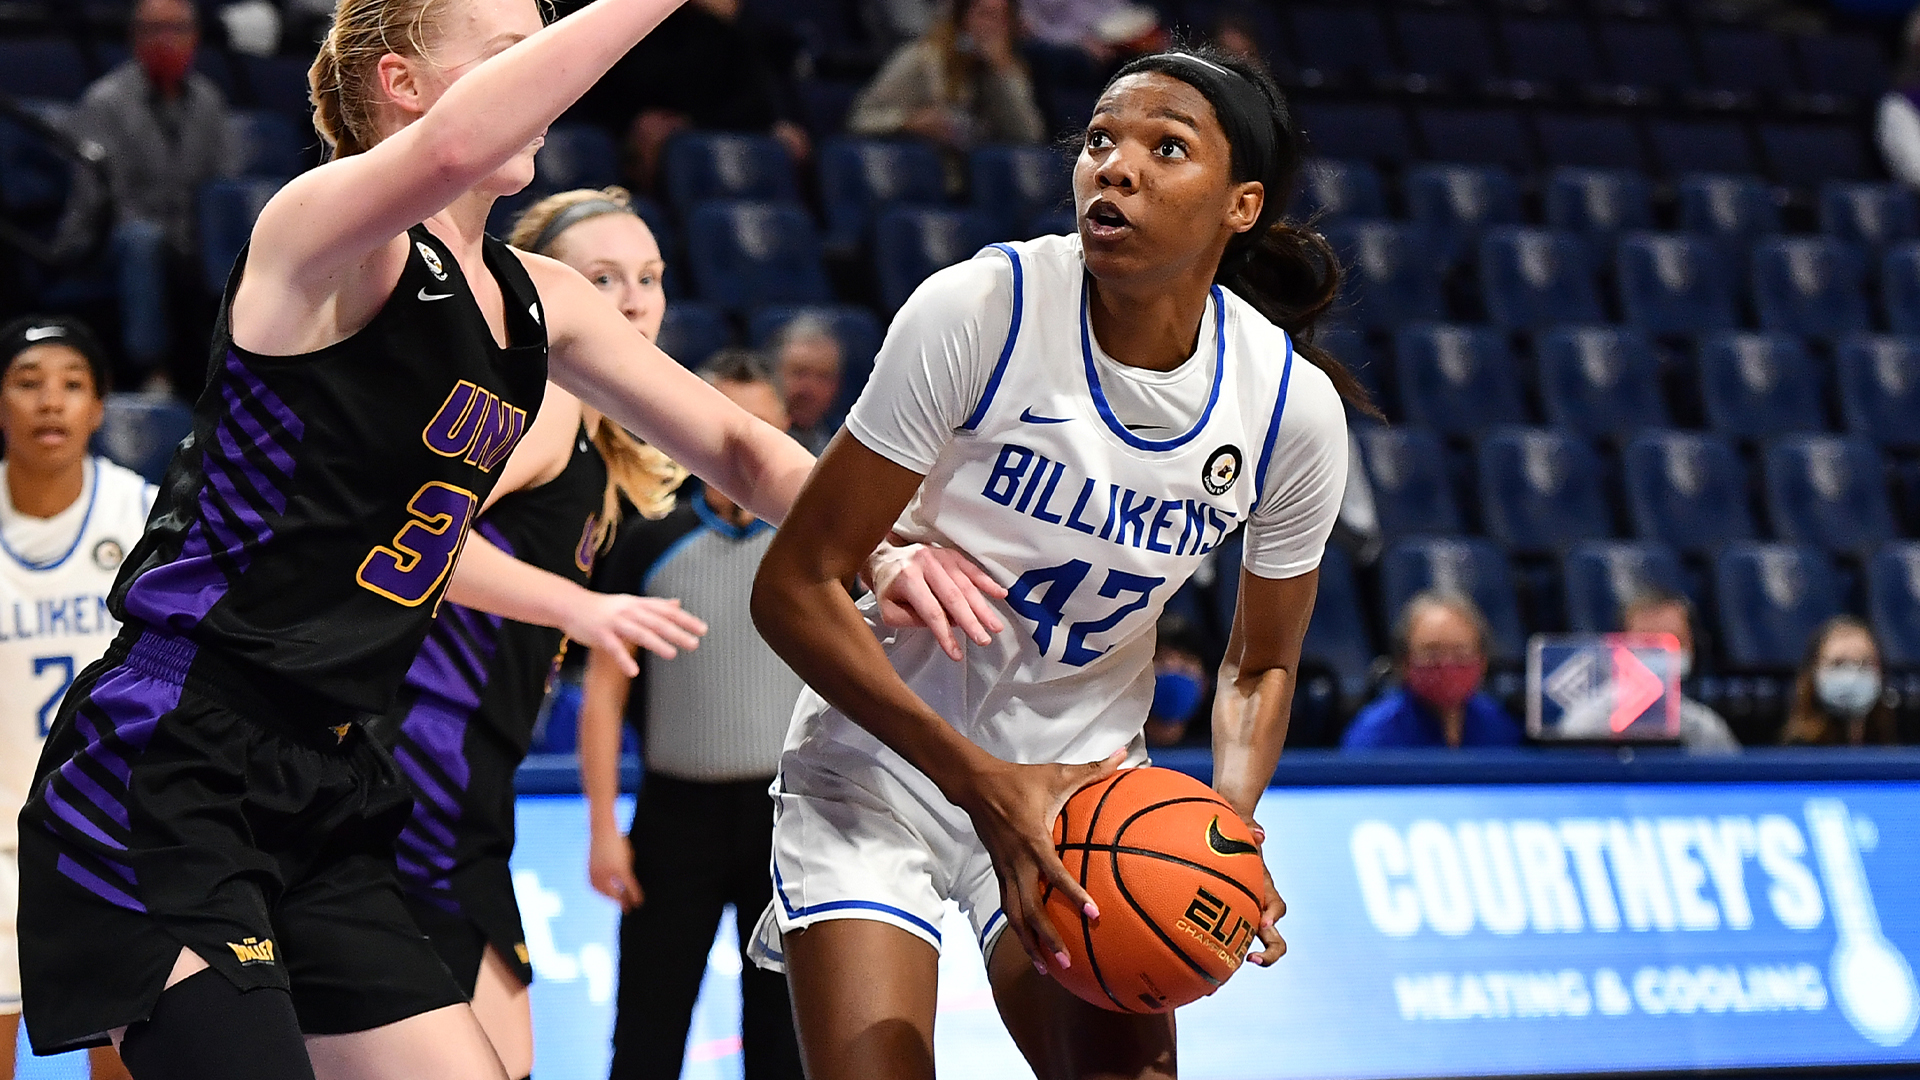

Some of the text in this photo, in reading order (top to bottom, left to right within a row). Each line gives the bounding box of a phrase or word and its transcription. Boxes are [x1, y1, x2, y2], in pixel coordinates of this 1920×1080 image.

[422, 379, 528, 473] UNI
[355, 480, 479, 618] 3
[980, 443, 1238, 557] BILLIKENS
[1006, 558, 1167, 667] 42
[1351, 812, 1825, 938] COURTNEY'S
[1393, 964, 1828, 1021] HEATING & COOLING
